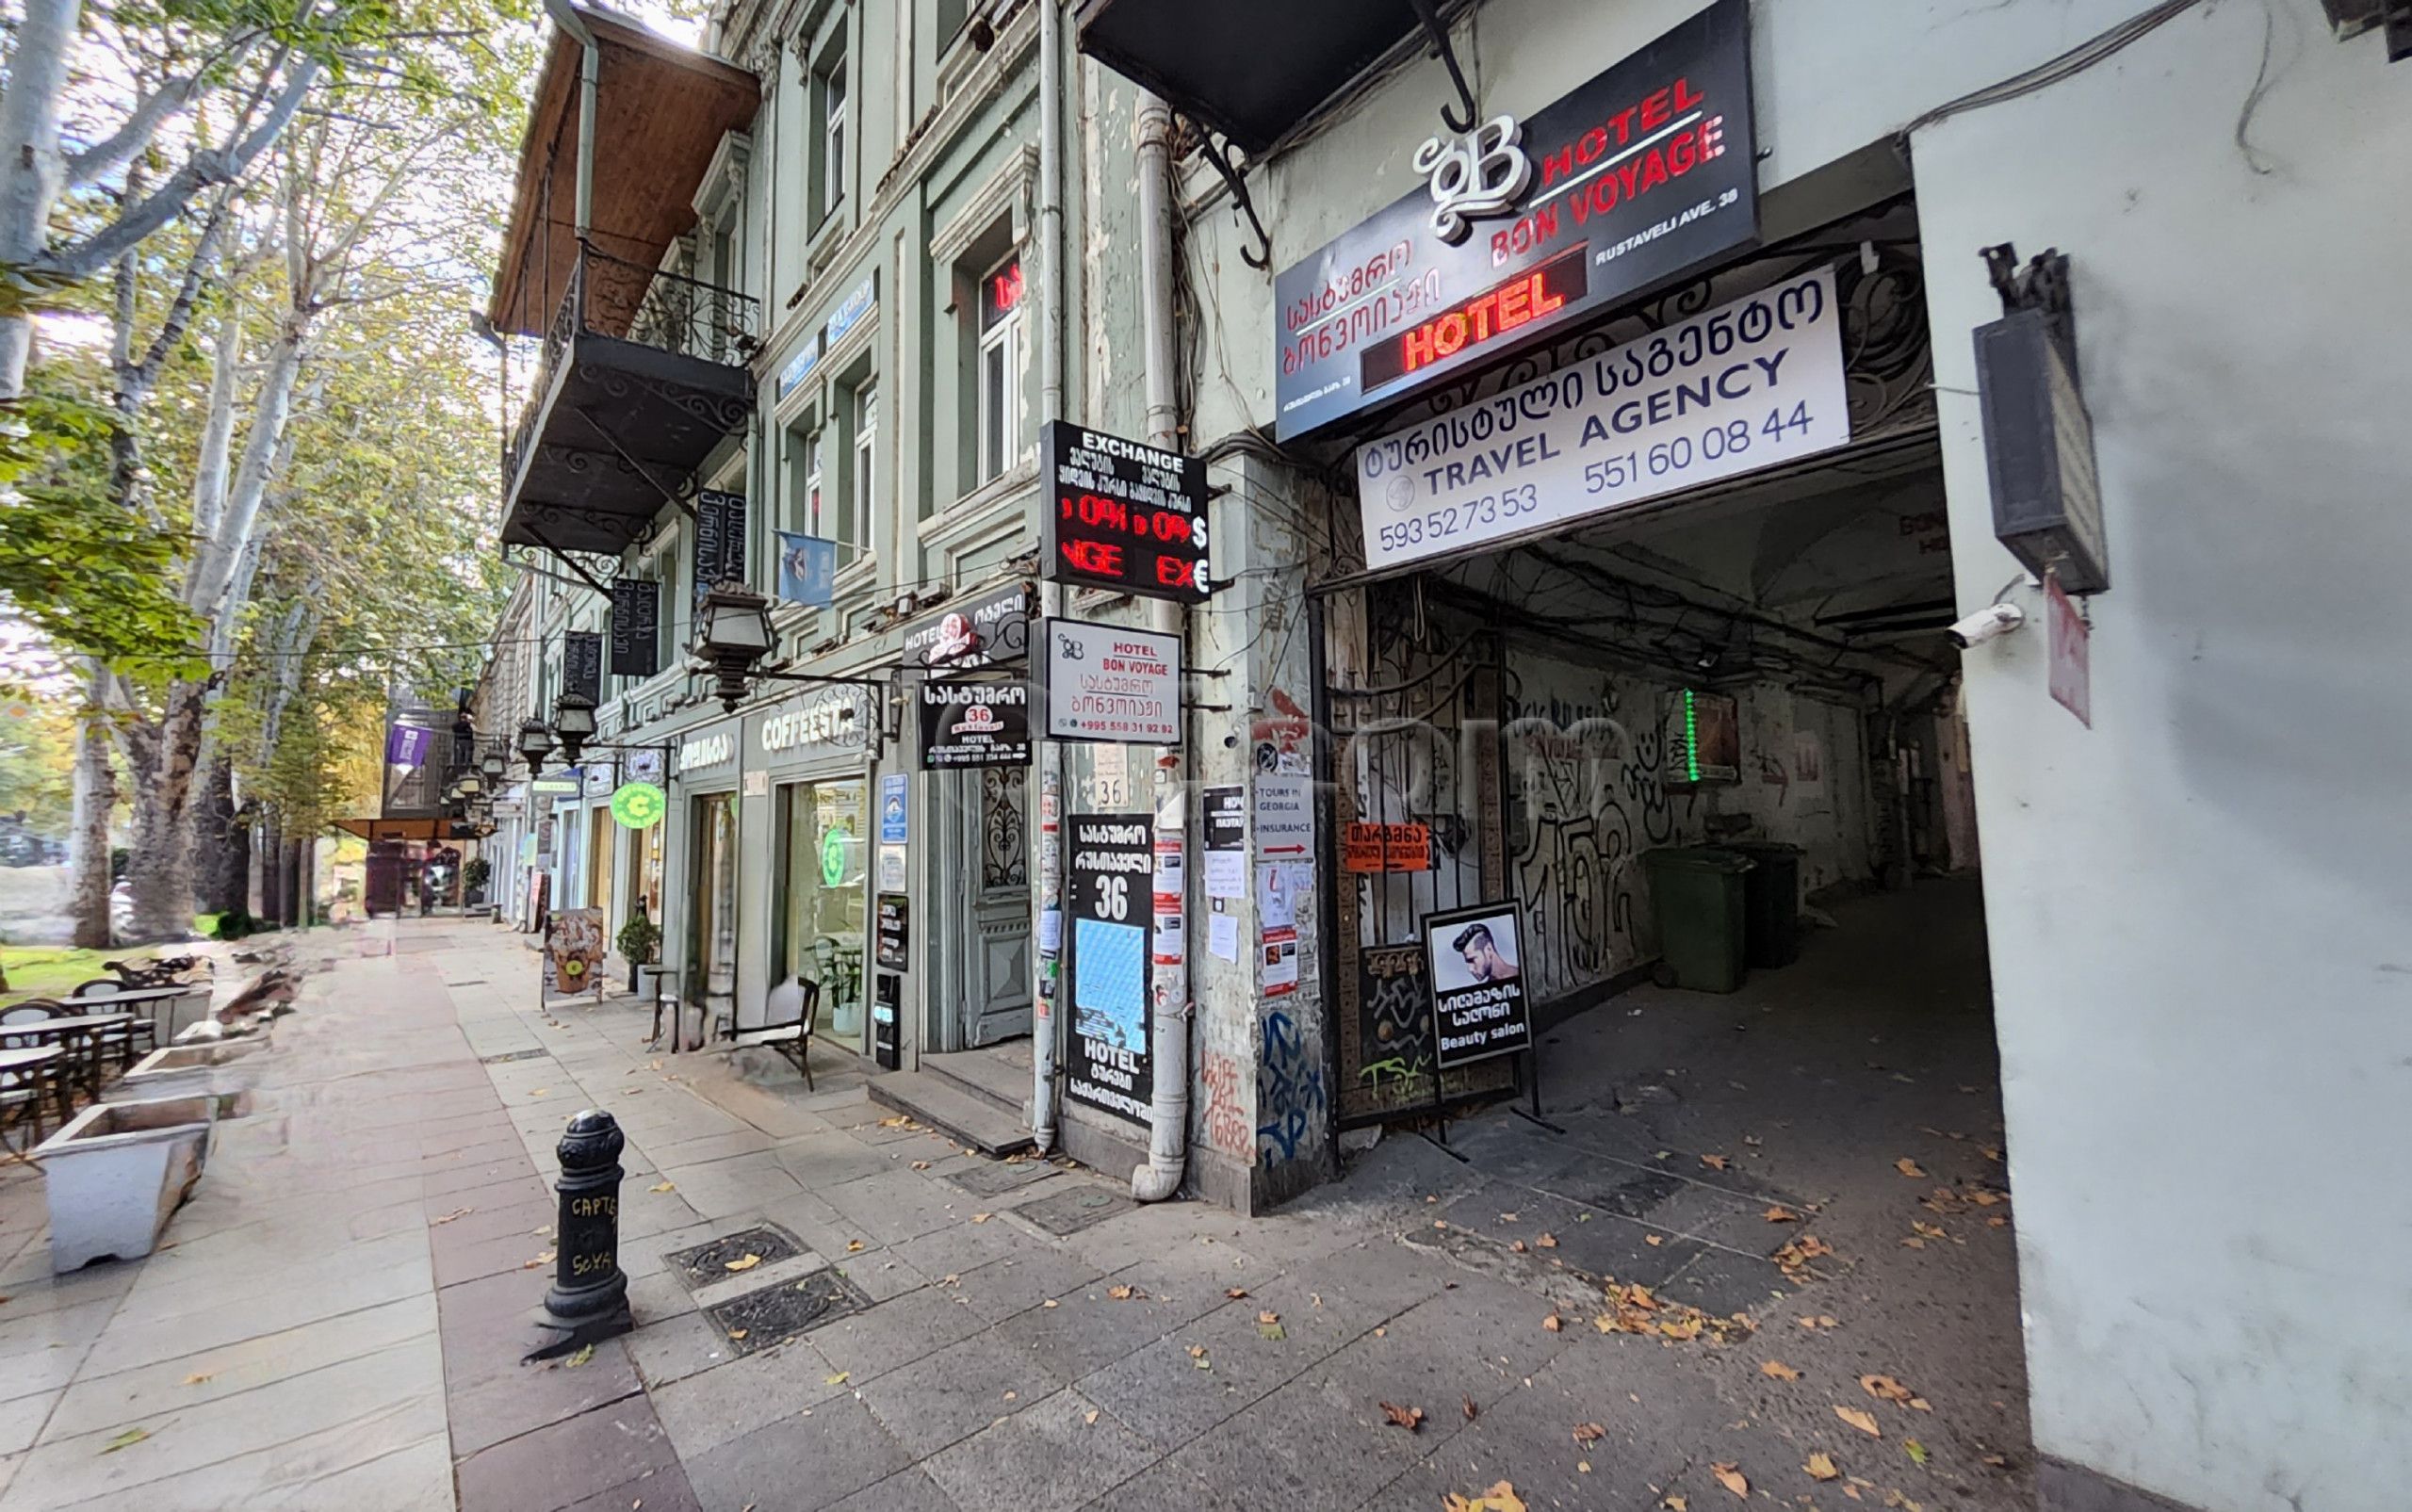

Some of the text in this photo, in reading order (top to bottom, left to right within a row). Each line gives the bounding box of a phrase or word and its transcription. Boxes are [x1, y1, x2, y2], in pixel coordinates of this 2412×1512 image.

[1542, 76, 1704, 187] HOTEL
[1491, 114, 1725, 268] BON VOYAGE
[1595, 217, 1677, 266] RUSTAVELI
[1286, 238, 1411, 332] სასტუმრო
[1401, 271, 1565, 373] HOTEL
[1364, 279, 1823, 479] ტურისტული საგენტო
[1424, 347, 1790, 496] TRAVEL AGENCY
[1082, 431, 1184, 474] EXCHANGE
[1584, 399, 1815, 495] 551 60 08 44
[1192, 515, 1208, 550] $
[1379, 483, 1538, 552] 593 52 73 53
[1193, 559, 1210, 593] €
[1113, 642, 1158, 658] HOTEL
[1102, 658, 1168, 676] BON VOYAGE
[924, 685, 1026, 705] სასტუმრო
[969, 708, 990, 723] 36
[961, 735, 995, 744] HOTEL
[1100, 779, 1122, 805] 36
[1260, 788, 1289, 798] TOURS
[1260, 802, 1300, 811] GEORGIA
[1079, 824, 1147, 845] სასტუმრო
[1260, 822, 1312, 834] INSURANCE
[1075, 851, 1151, 874] რუსთაველი
[1095, 874, 1128, 921] 36
[1437, 983, 1522, 1014] სილამაზის
[1452, 1001, 1511, 1027] სალონი
[1440, 1022, 1525, 1051] Beauty salon
[1084, 1037, 1140, 1075] HOTEL
